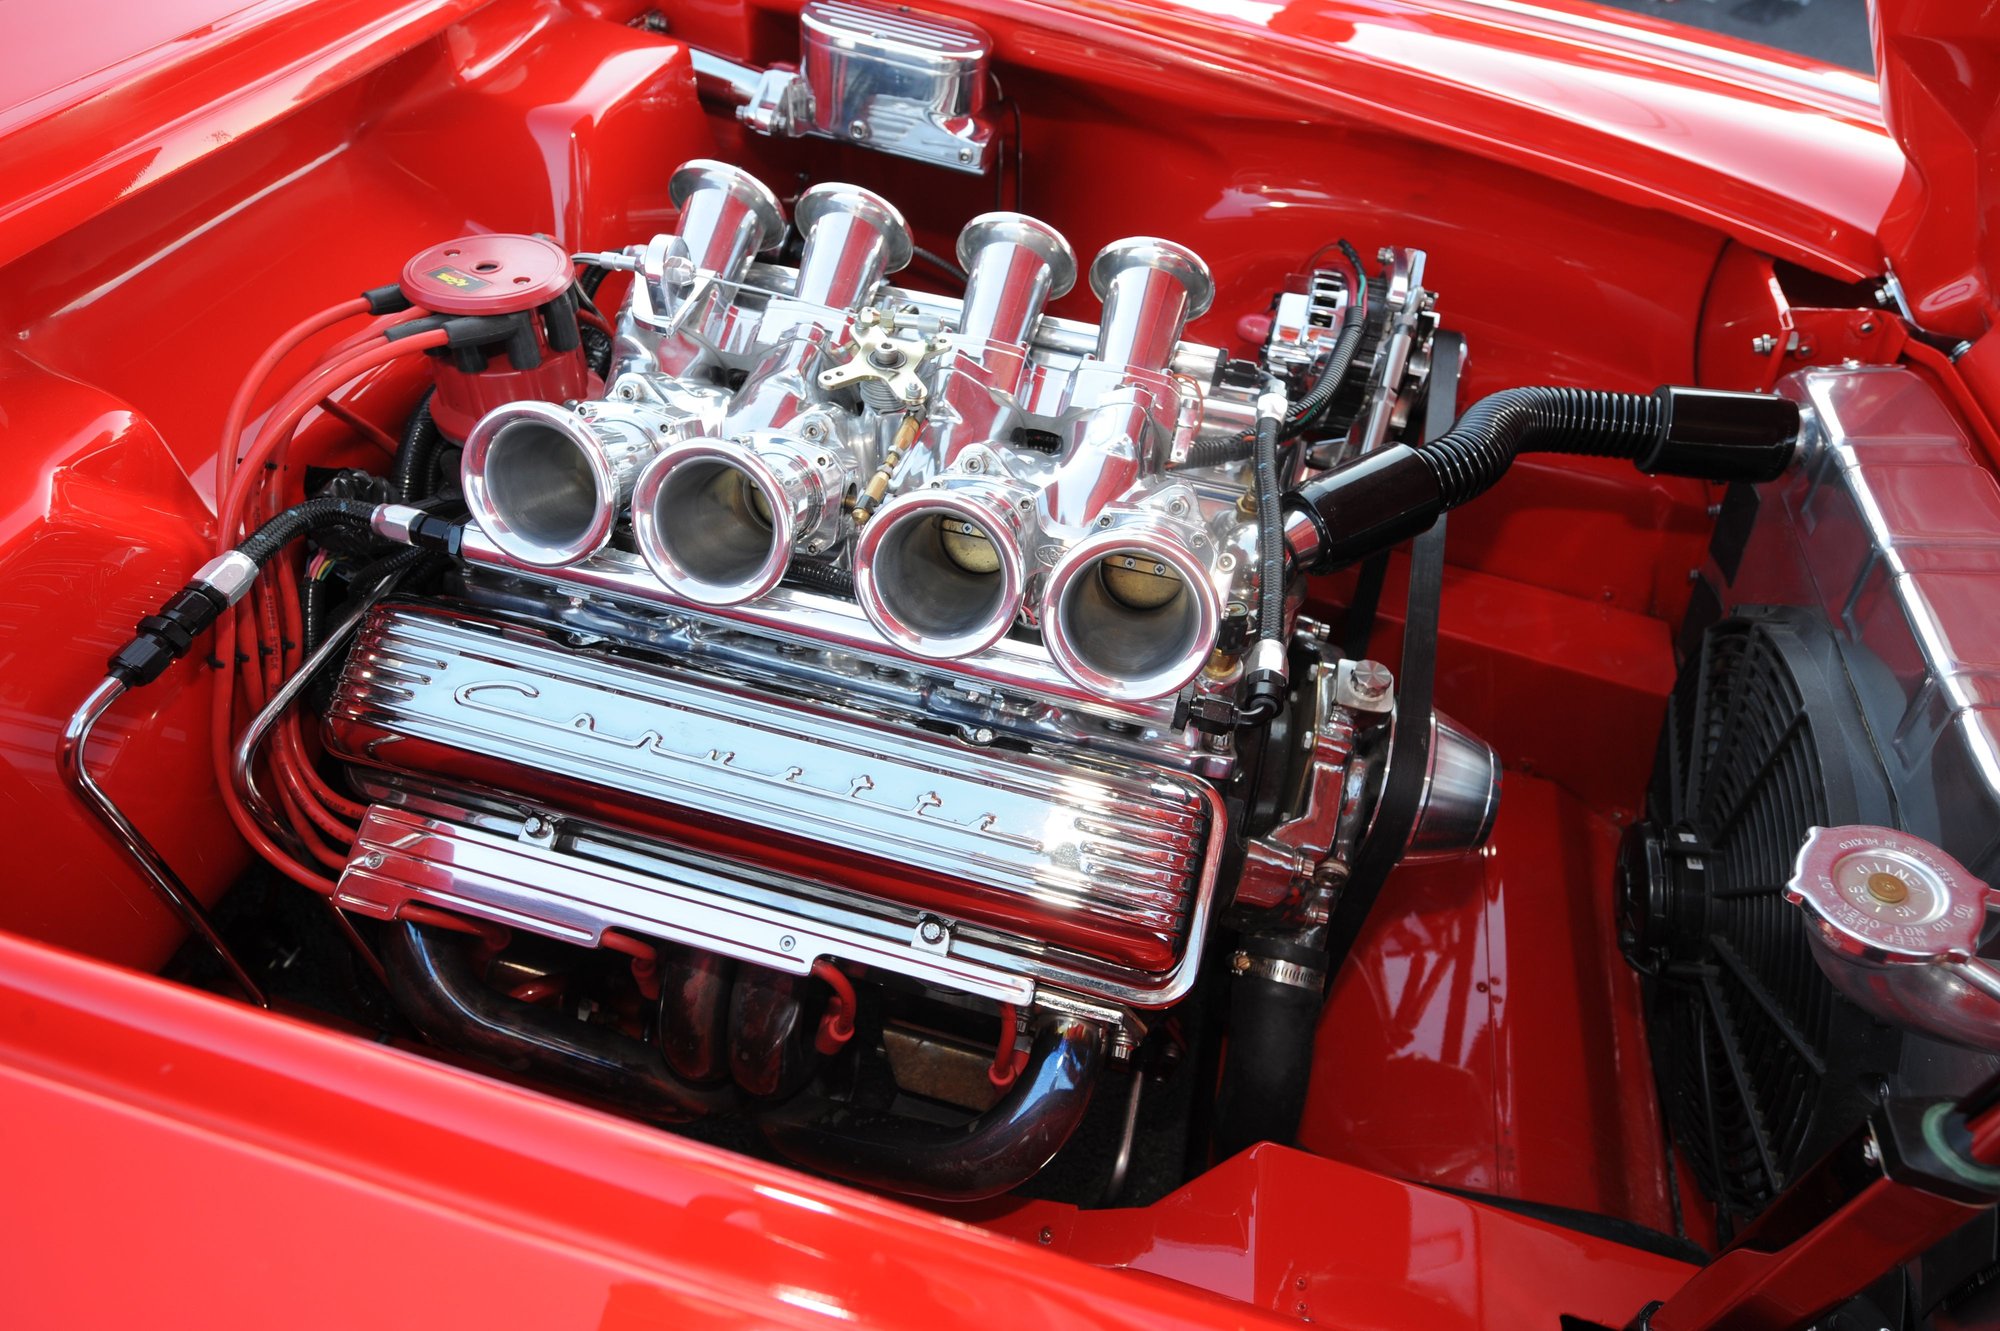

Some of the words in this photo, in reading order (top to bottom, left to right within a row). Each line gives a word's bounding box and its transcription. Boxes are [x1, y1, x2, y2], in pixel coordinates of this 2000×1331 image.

[1824, 904, 1871, 936] TIGHT
[1893, 925, 1928, 937] NOT
[1883, 933, 1927, 948] KEEP
